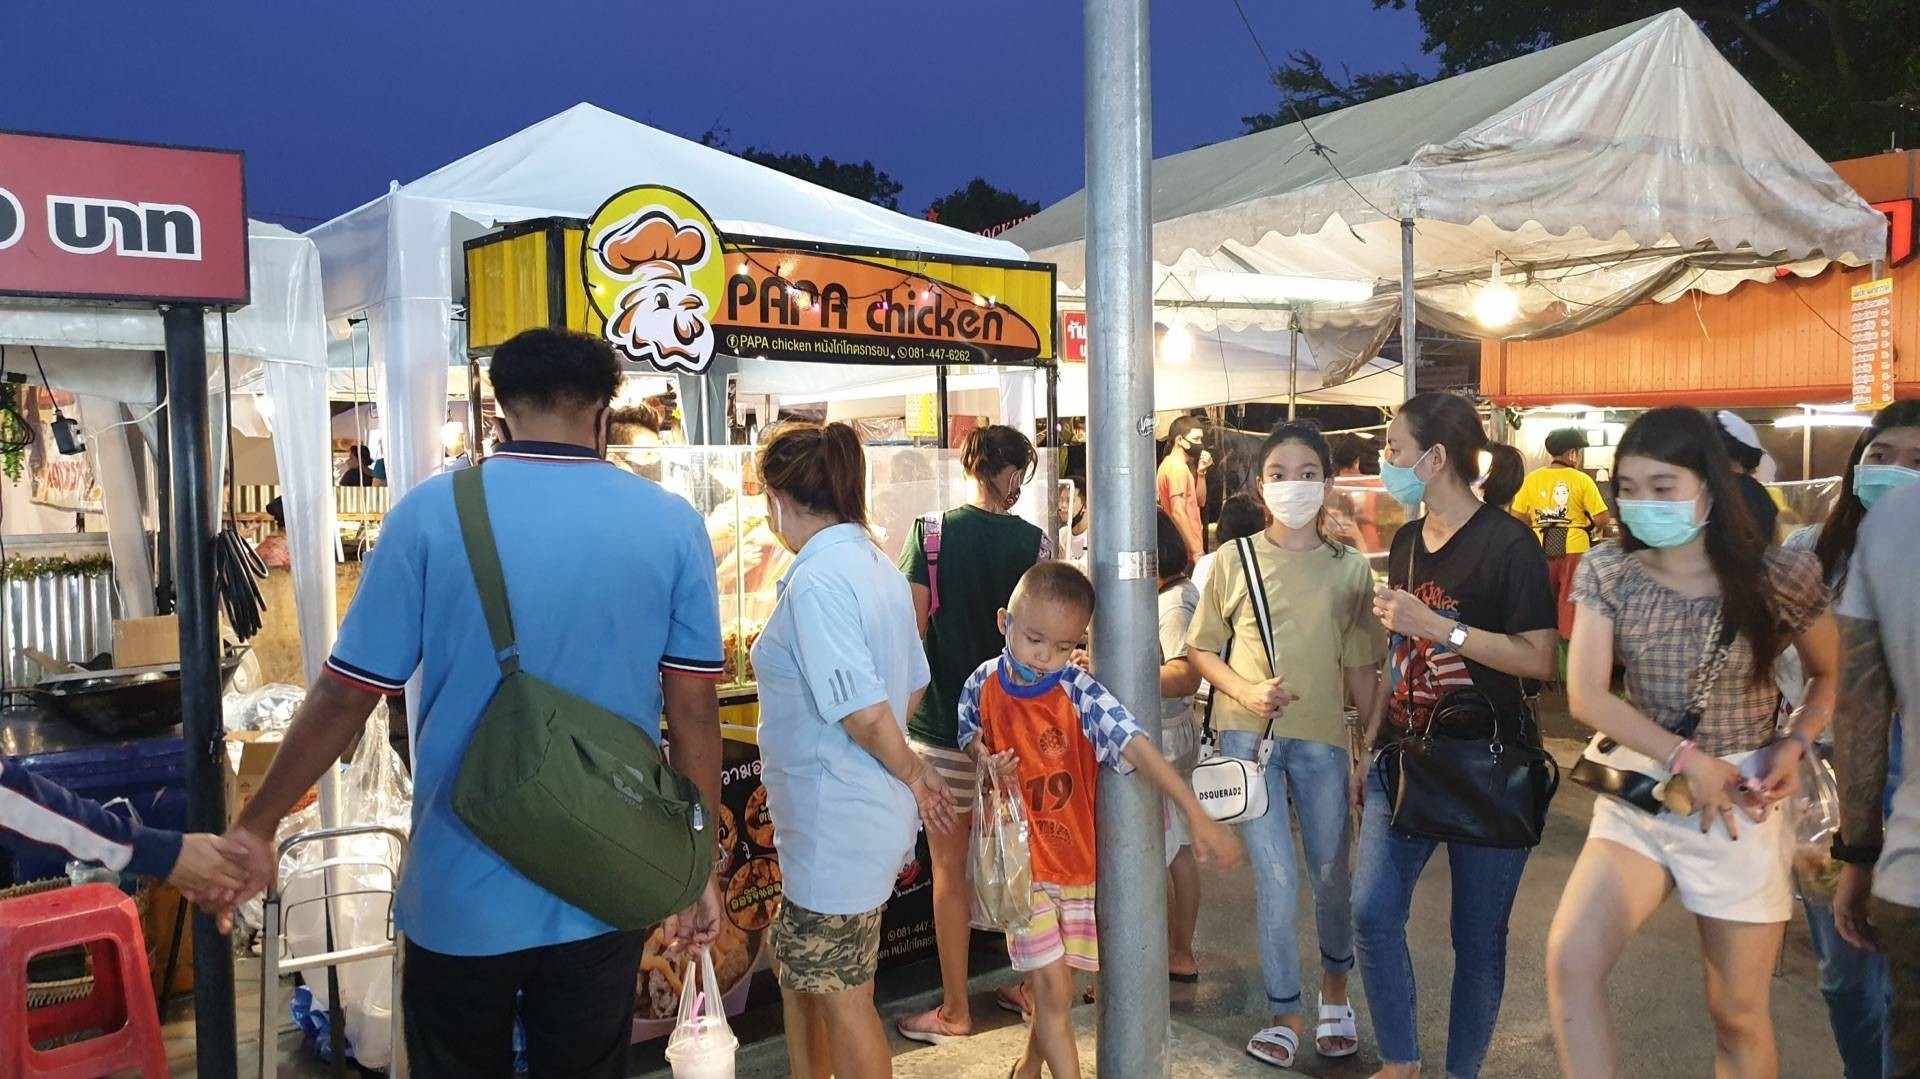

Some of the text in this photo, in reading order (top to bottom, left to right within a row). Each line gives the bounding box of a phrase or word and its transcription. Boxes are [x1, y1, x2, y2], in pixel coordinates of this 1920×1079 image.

[47, 195, 202, 260] บาท
[727, 273, 1004, 342] PAPA chicken
[740, 334, 970, 362] PAPA chicken หนังไก่โคตรกรอบ 081-447-6262
[1025, 768, 1074, 813] 19
